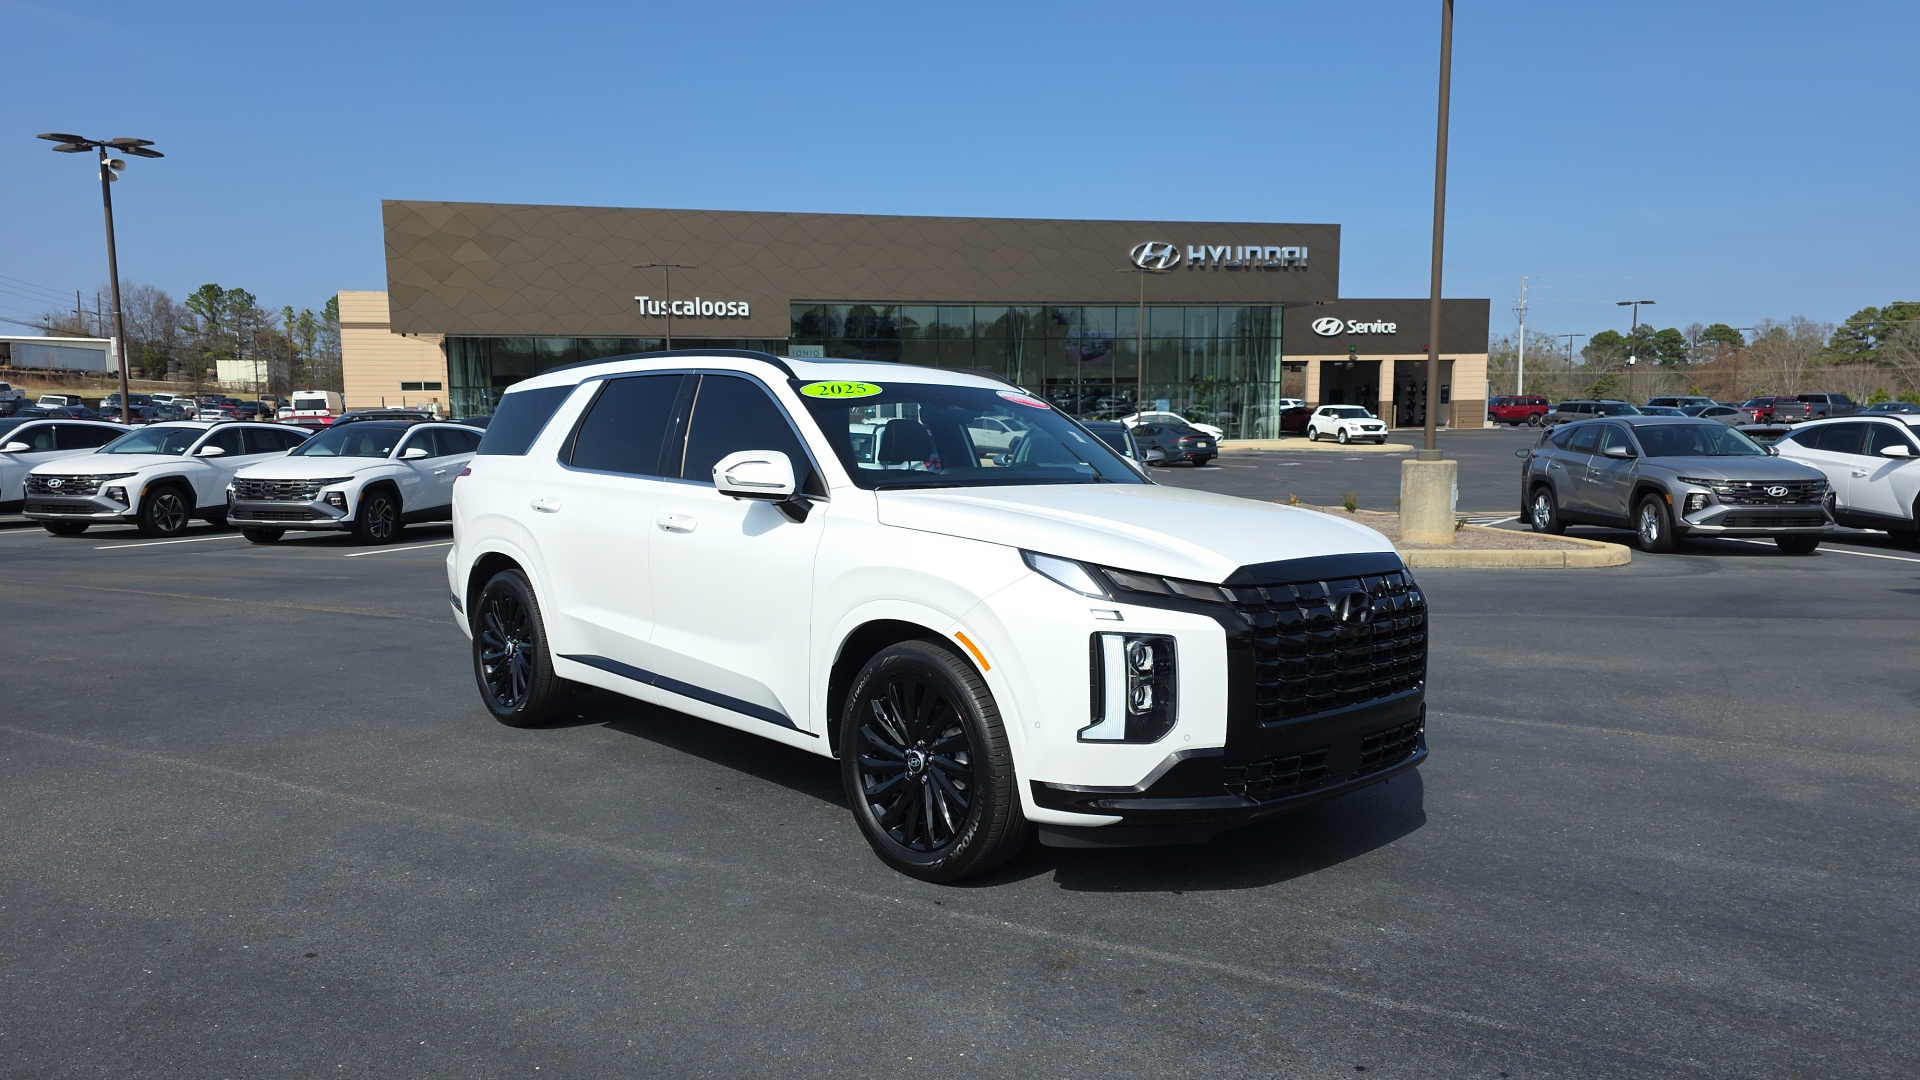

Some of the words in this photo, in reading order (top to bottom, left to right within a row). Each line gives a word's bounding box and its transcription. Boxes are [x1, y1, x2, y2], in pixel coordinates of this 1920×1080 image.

[1187, 245, 1308, 267] HYUNDAI
[634, 295, 749, 317] Tuscaloosa
[1346, 319, 1397, 334] Service
[817, 383, 867, 396] 2025
